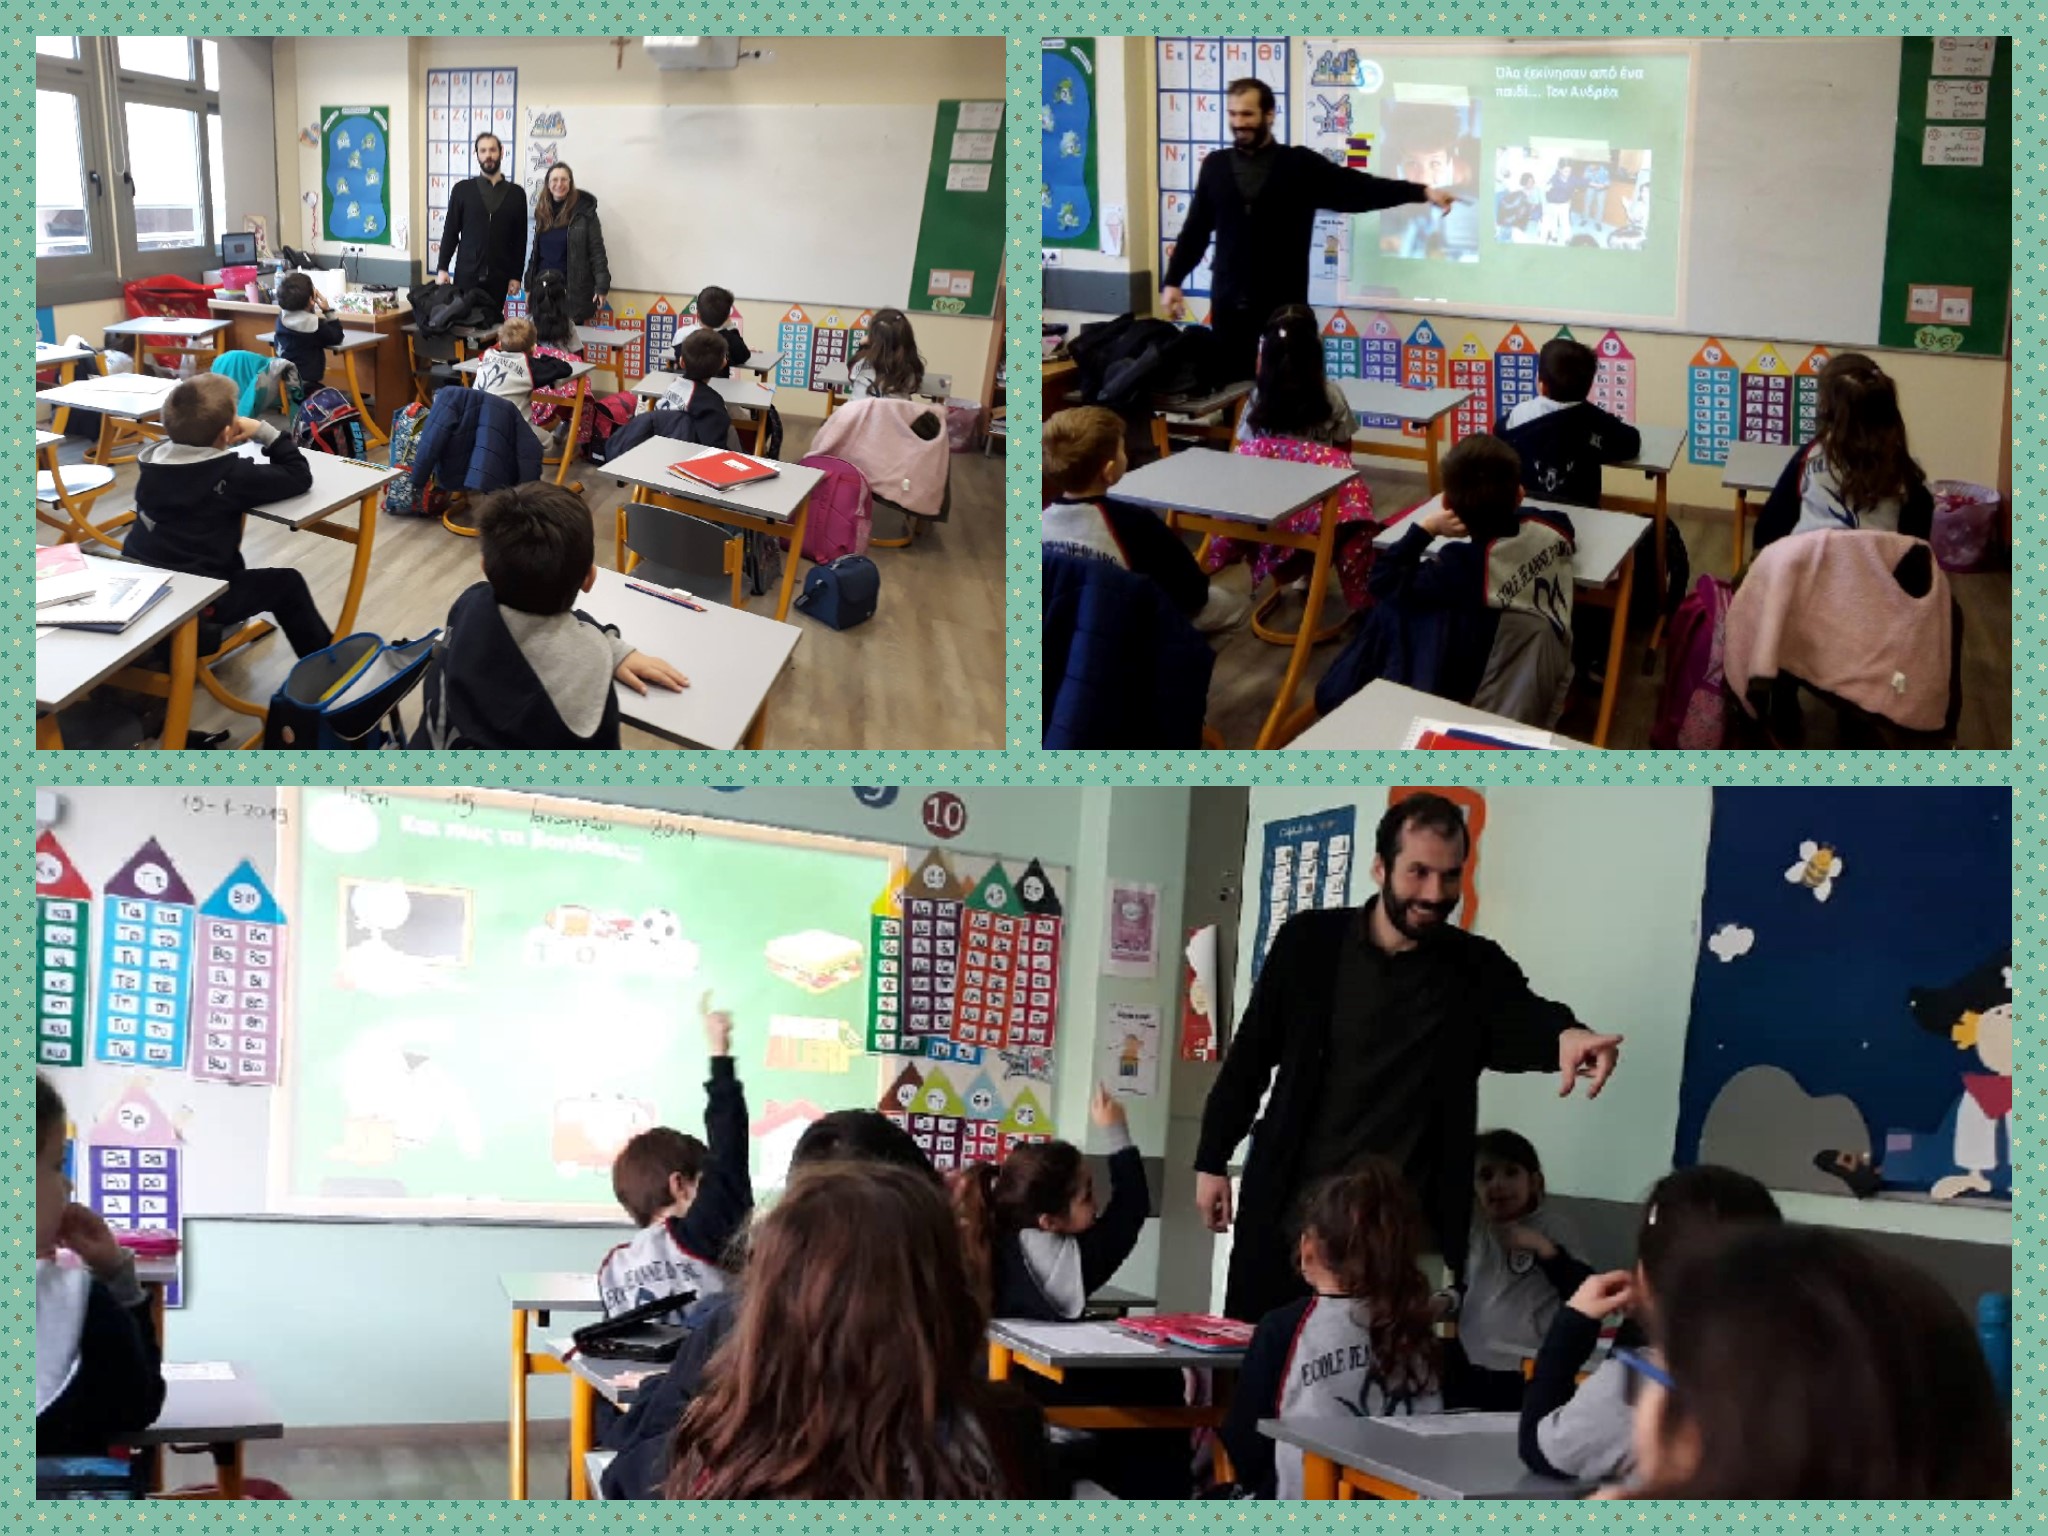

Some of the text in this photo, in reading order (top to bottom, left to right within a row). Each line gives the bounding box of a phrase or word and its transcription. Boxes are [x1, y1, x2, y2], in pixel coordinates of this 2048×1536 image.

[1523, 66, 1587, 81] ξεκίνησαν
[1589, 66, 1617, 80] από
[1620, 66, 1645, 80] ένα
[927, 798, 963, 831] 10
[1301, 1348, 1344, 1386] ECOLE
